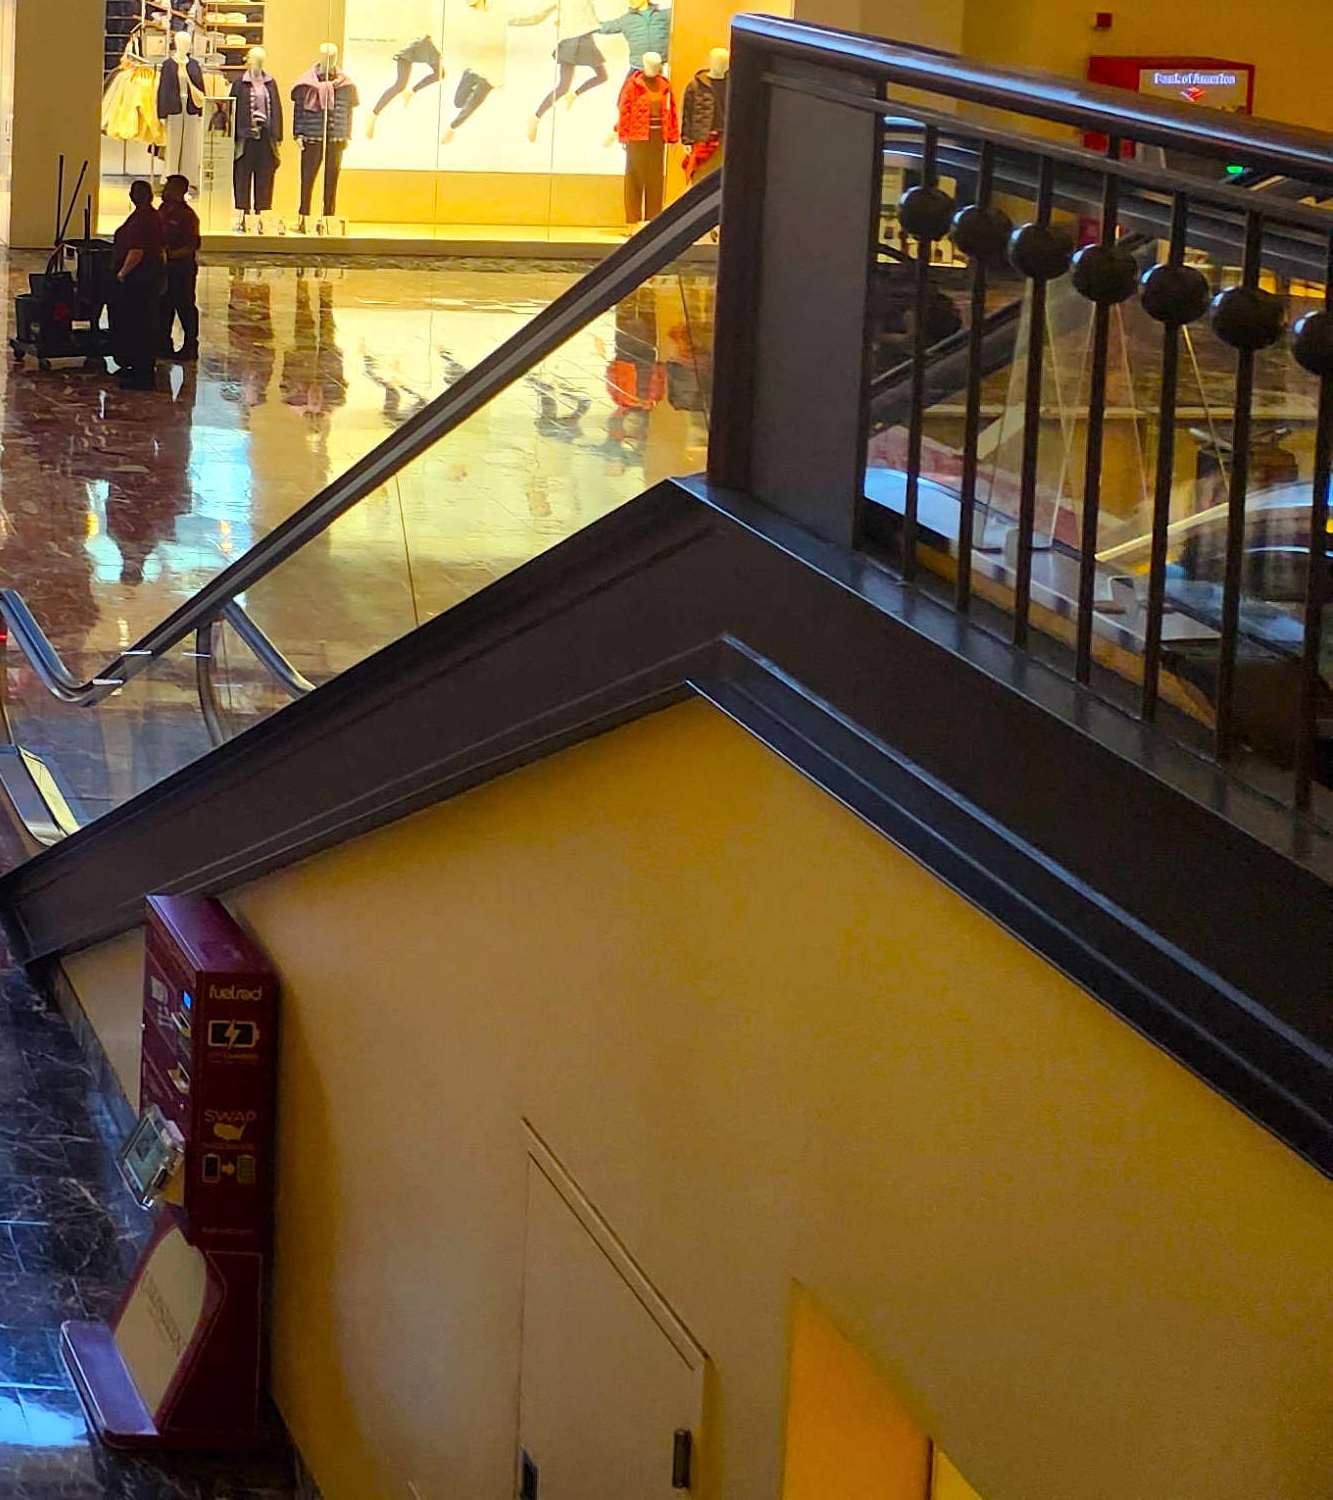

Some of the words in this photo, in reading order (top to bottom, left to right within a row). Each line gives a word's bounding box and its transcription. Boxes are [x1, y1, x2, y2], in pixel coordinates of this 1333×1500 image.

[1154, 73, 1181, 85] Bank
[1182, 73, 1193, 85] of
[1193, 73, 1236, 85] America
[209, 983, 263, 1002] fuelrod
[204, 1110, 256, 1123] SWAP
